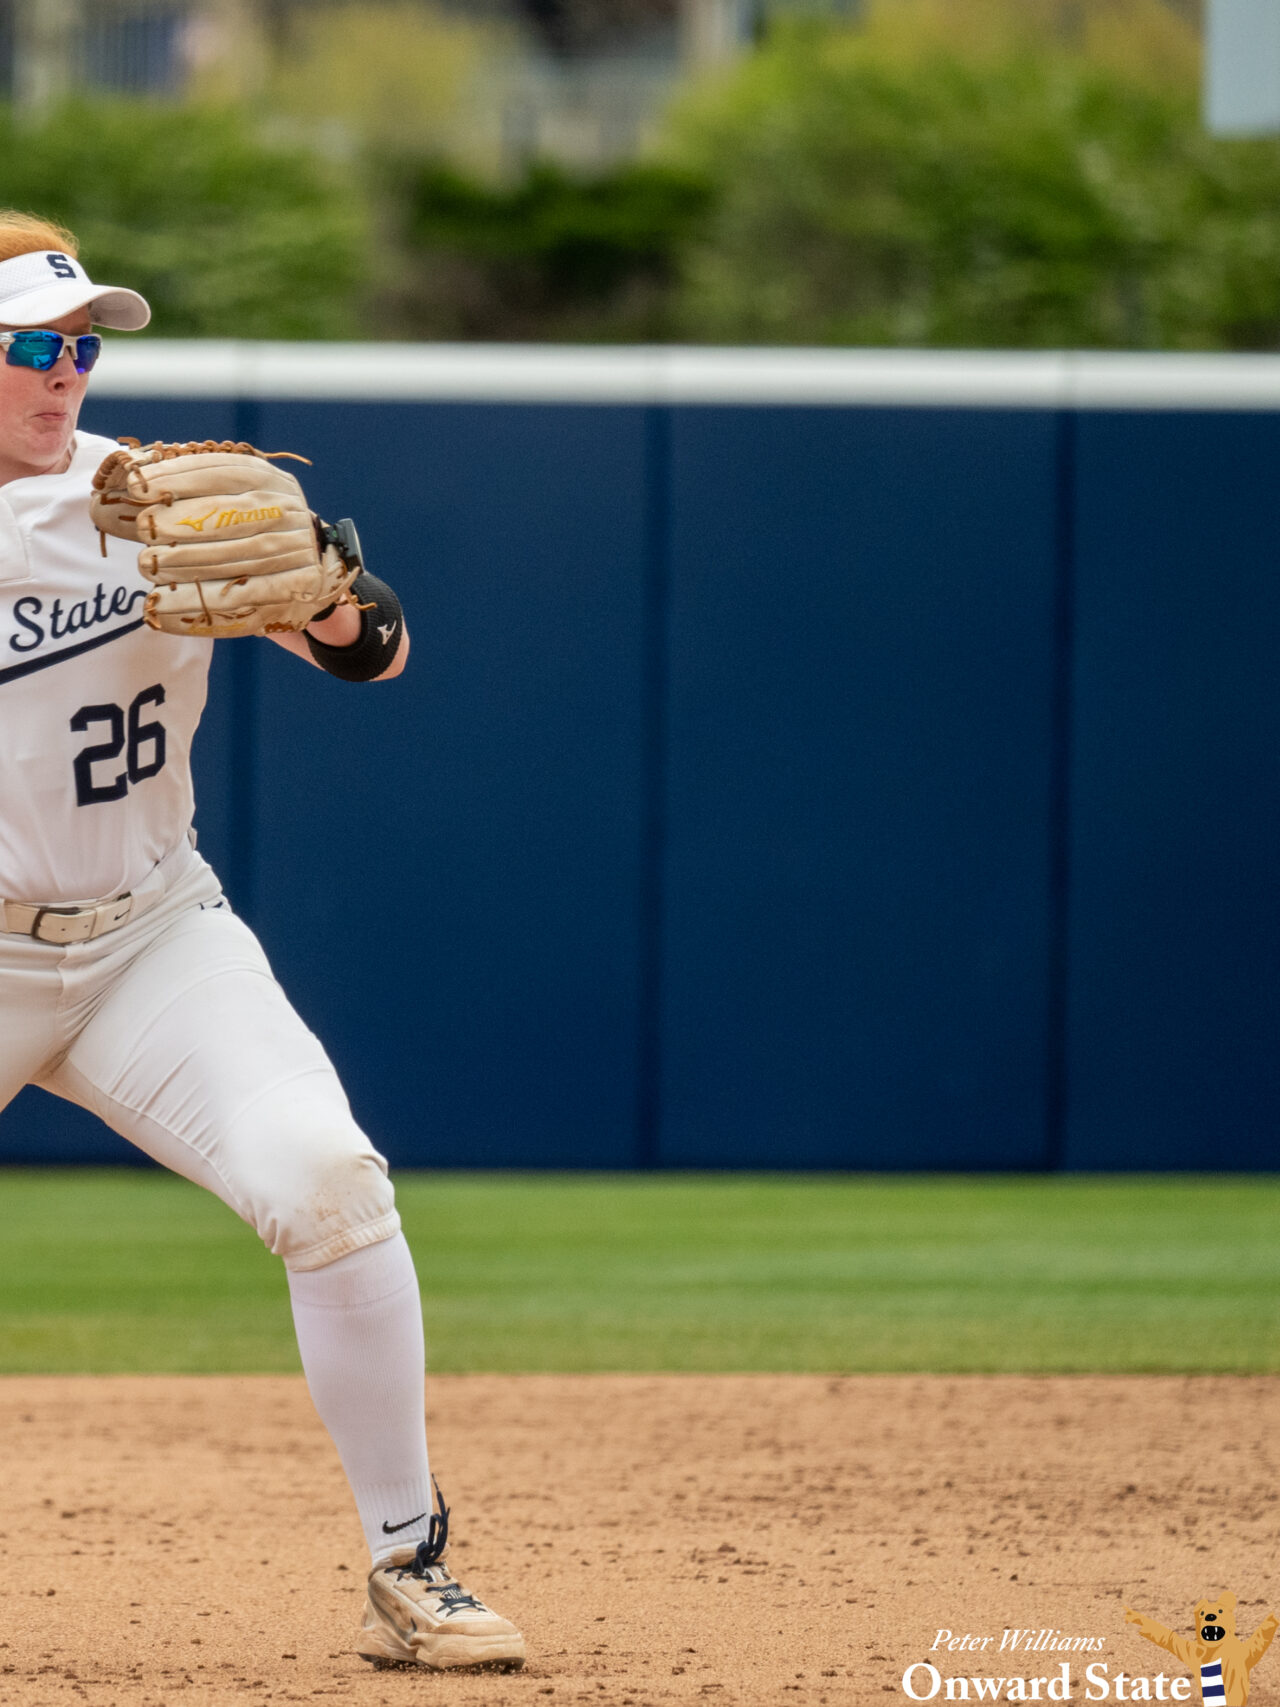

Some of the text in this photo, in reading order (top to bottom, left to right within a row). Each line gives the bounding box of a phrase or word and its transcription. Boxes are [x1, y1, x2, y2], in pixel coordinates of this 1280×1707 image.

[46, 254, 77, 279] S
[9, 582, 148, 652] State
[70, 683, 166, 807] 26
